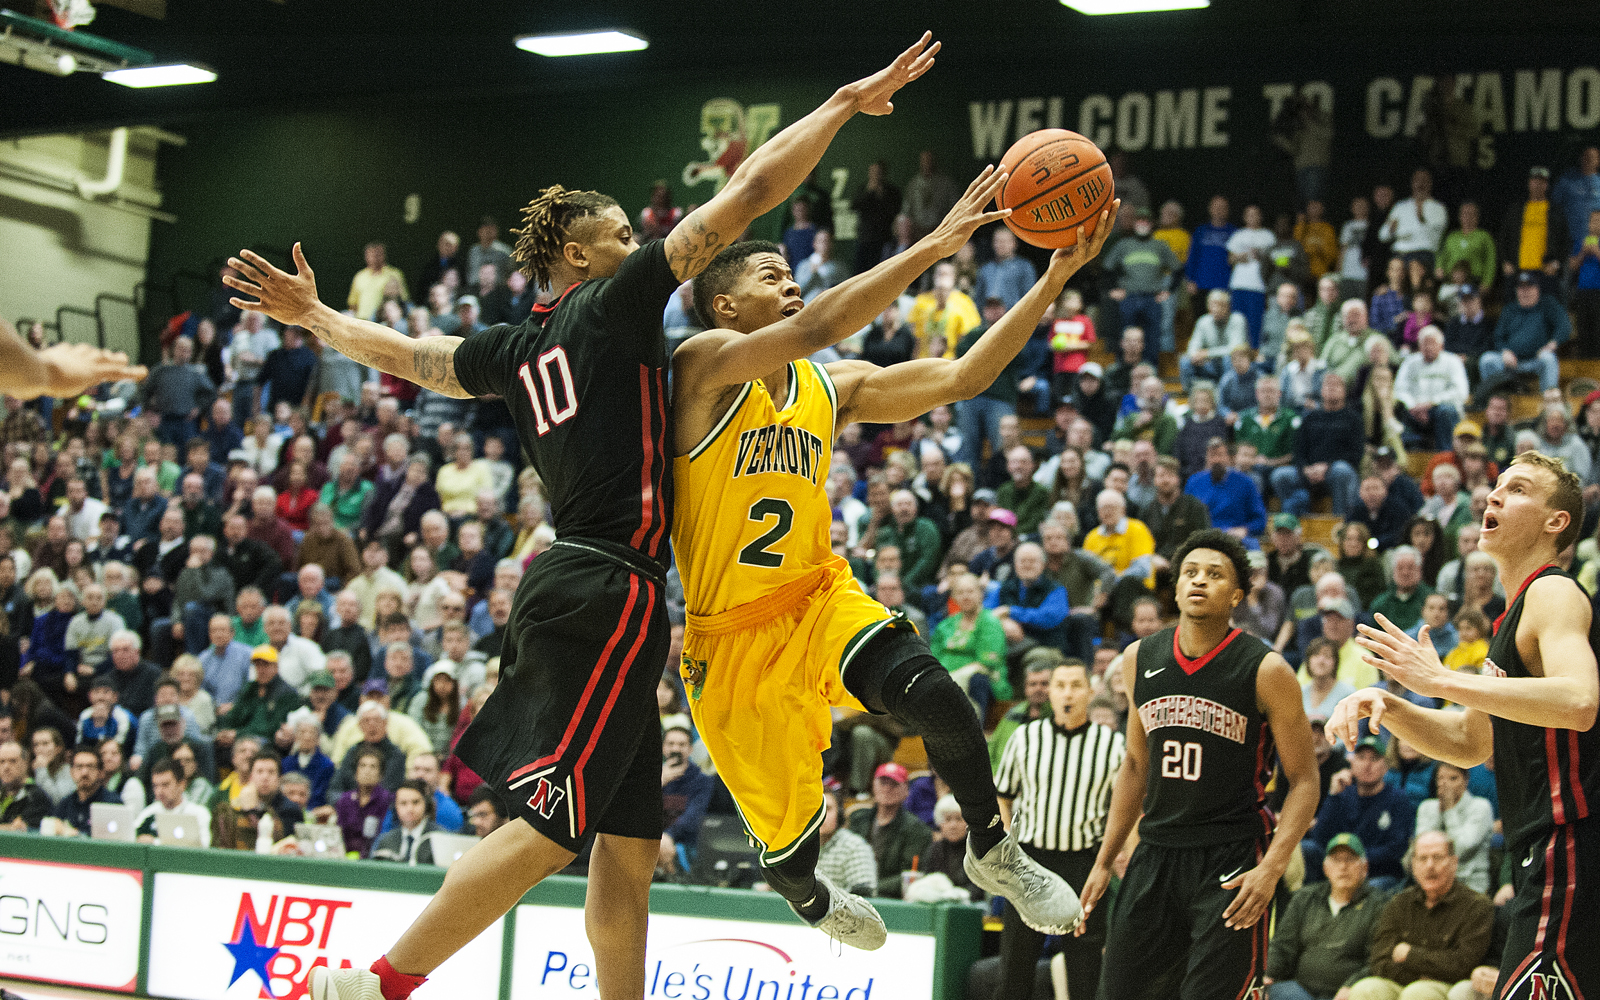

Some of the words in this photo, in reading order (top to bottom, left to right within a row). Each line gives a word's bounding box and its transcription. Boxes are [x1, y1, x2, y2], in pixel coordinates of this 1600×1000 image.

[1030, 193, 1077, 223] ROCK
[1077, 175, 1106, 210] THE
[518, 344, 579, 437] 10
[732, 422, 823, 487] VERMONT
[737, 496, 795, 569] 2
[1161, 739, 1203, 782] 20
[526, 776, 566, 820] N
[230, 892, 353, 949] NBT
[541, 950, 713, 1000] Pele's
[723, 965, 875, 1000] United
